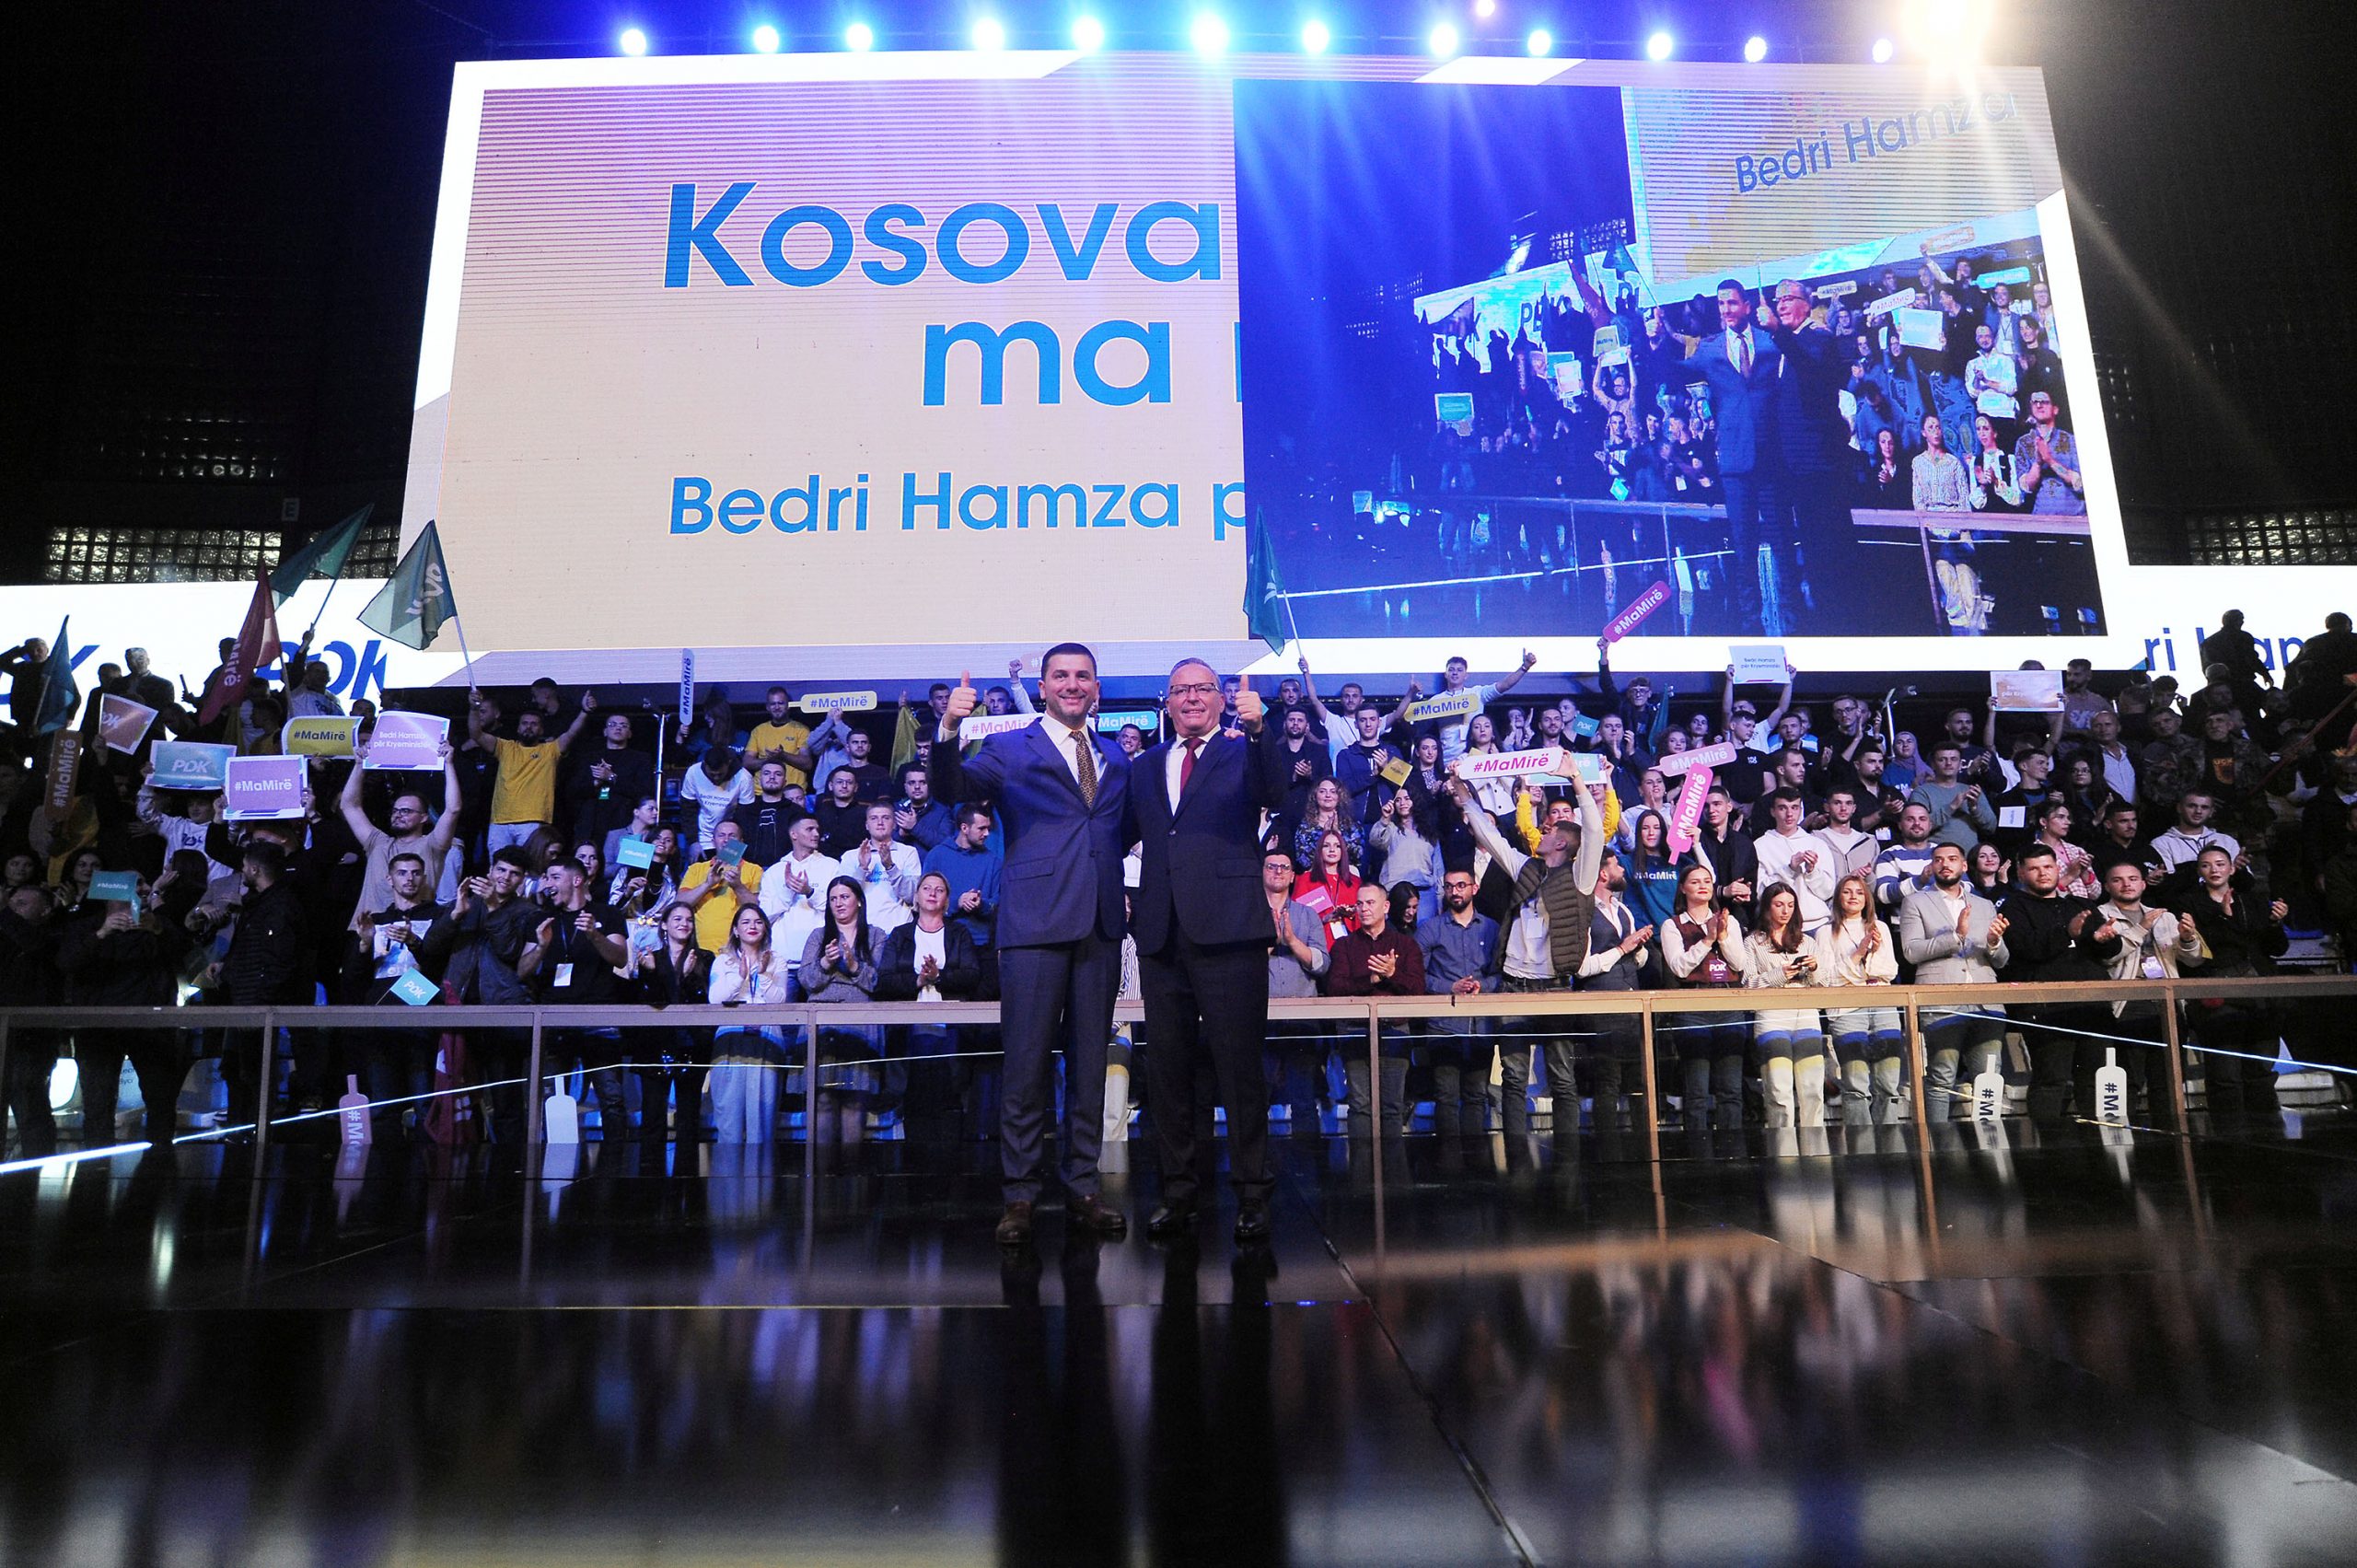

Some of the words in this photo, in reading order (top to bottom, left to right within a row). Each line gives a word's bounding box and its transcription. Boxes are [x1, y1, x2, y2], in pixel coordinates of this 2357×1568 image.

[1736, 131, 1831, 192] Bedri
[1844, 90, 2019, 166] Hamza
[664, 181, 1223, 288] Kosova
[923, 319, 1172, 407] ma
[670, 472, 869, 535] Bedri
[901, 471, 1179, 530] Hamza
[1614, 590, 1663, 634] #MaMirë
[682, 656, 692, 716] #MaMirë
[810, 695, 868, 708] #MaMirë
[1413, 698, 1469, 716] #MaMirë
[100, 712, 121, 728] DK
[971, 718, 1035, 735] #MaMir
[1098, 715, 1148, 728] MaMirë
[294, 730, 345, 742] #MaMirë
[172, 760, 209, 773] PDK
[1473, 754, 1550, 772] #MaMirë
[1671, 749, 1727, 771] #MaMirë
[52, 738, 76, 808] #MaMirë
[235, 778, 292, 792] #MaMirë
[1677, 773, 1706, 841] #MaMirë
[404, 981, 426, 999] PDK
